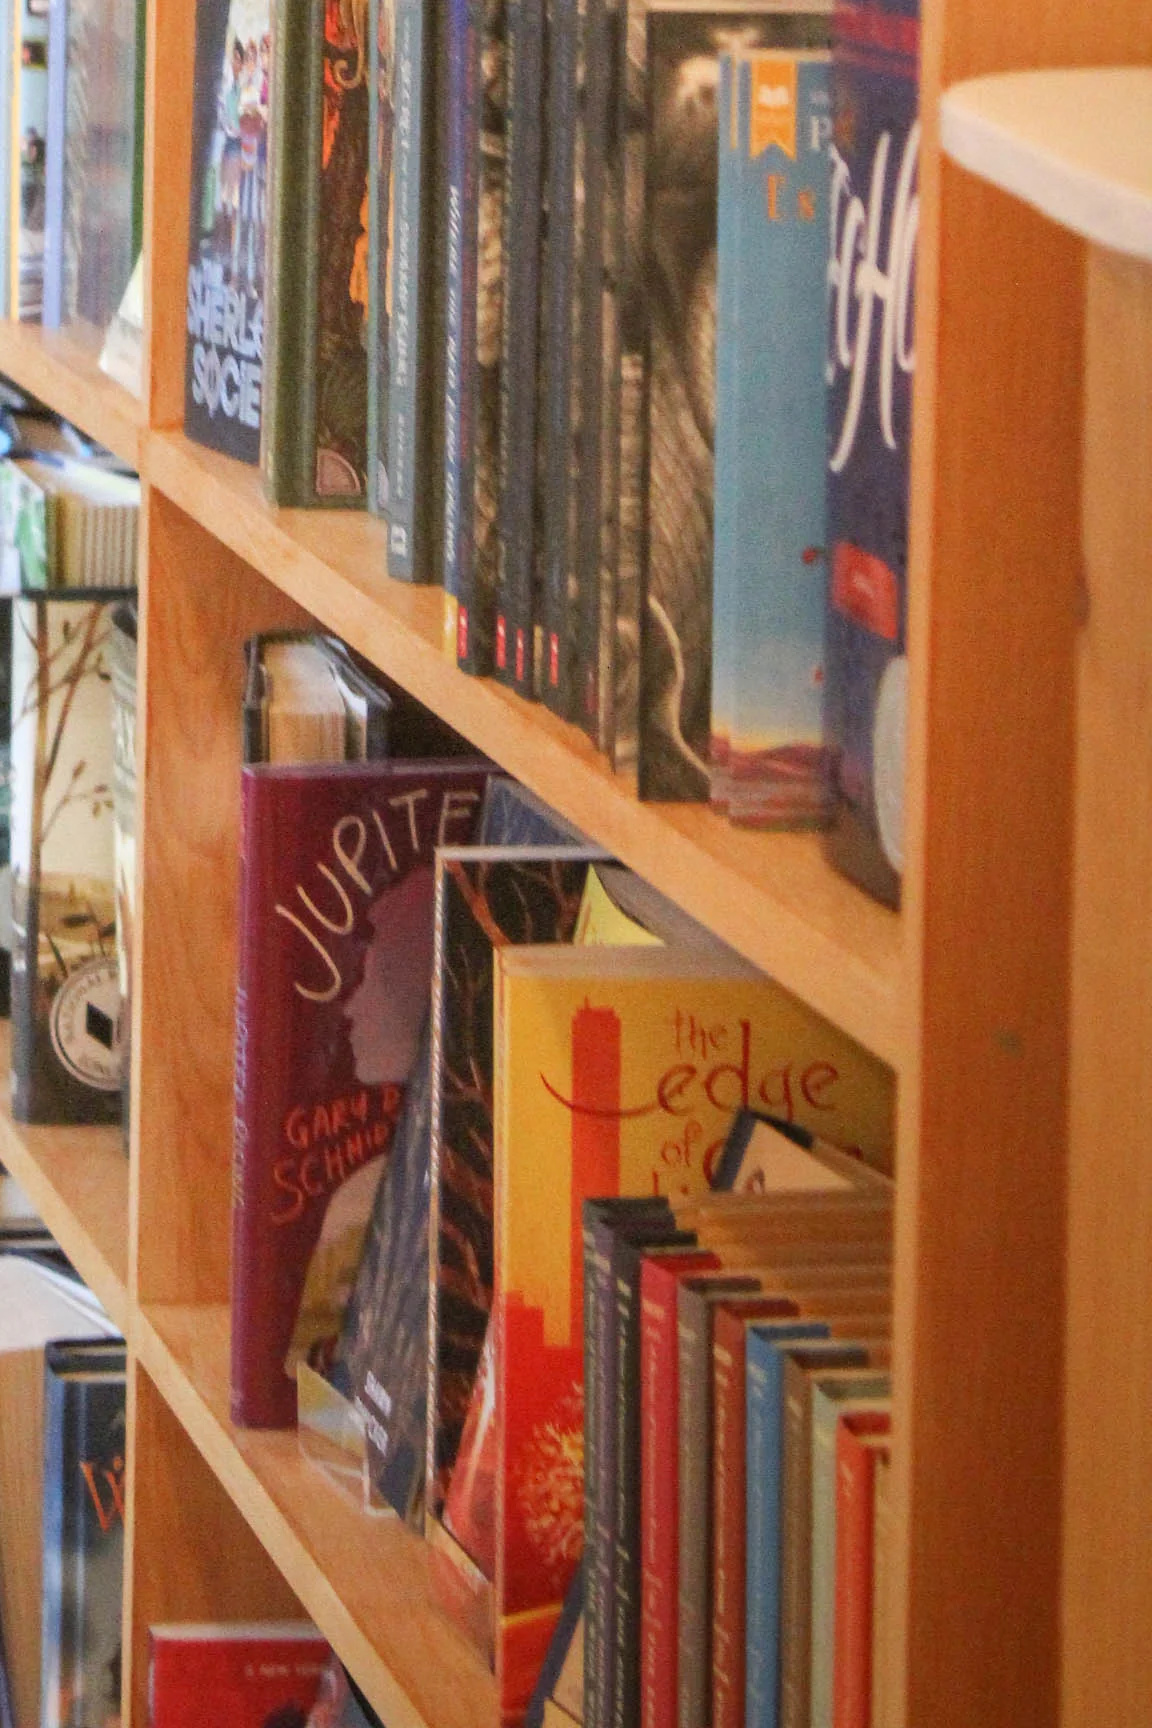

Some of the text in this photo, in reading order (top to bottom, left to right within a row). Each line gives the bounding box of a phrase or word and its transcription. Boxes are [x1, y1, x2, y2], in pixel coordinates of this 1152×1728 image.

[672, 1007, 729, 1061] the
[655, 1016, 840, 1127] edge
[660, 1119, 703, 1169] of
